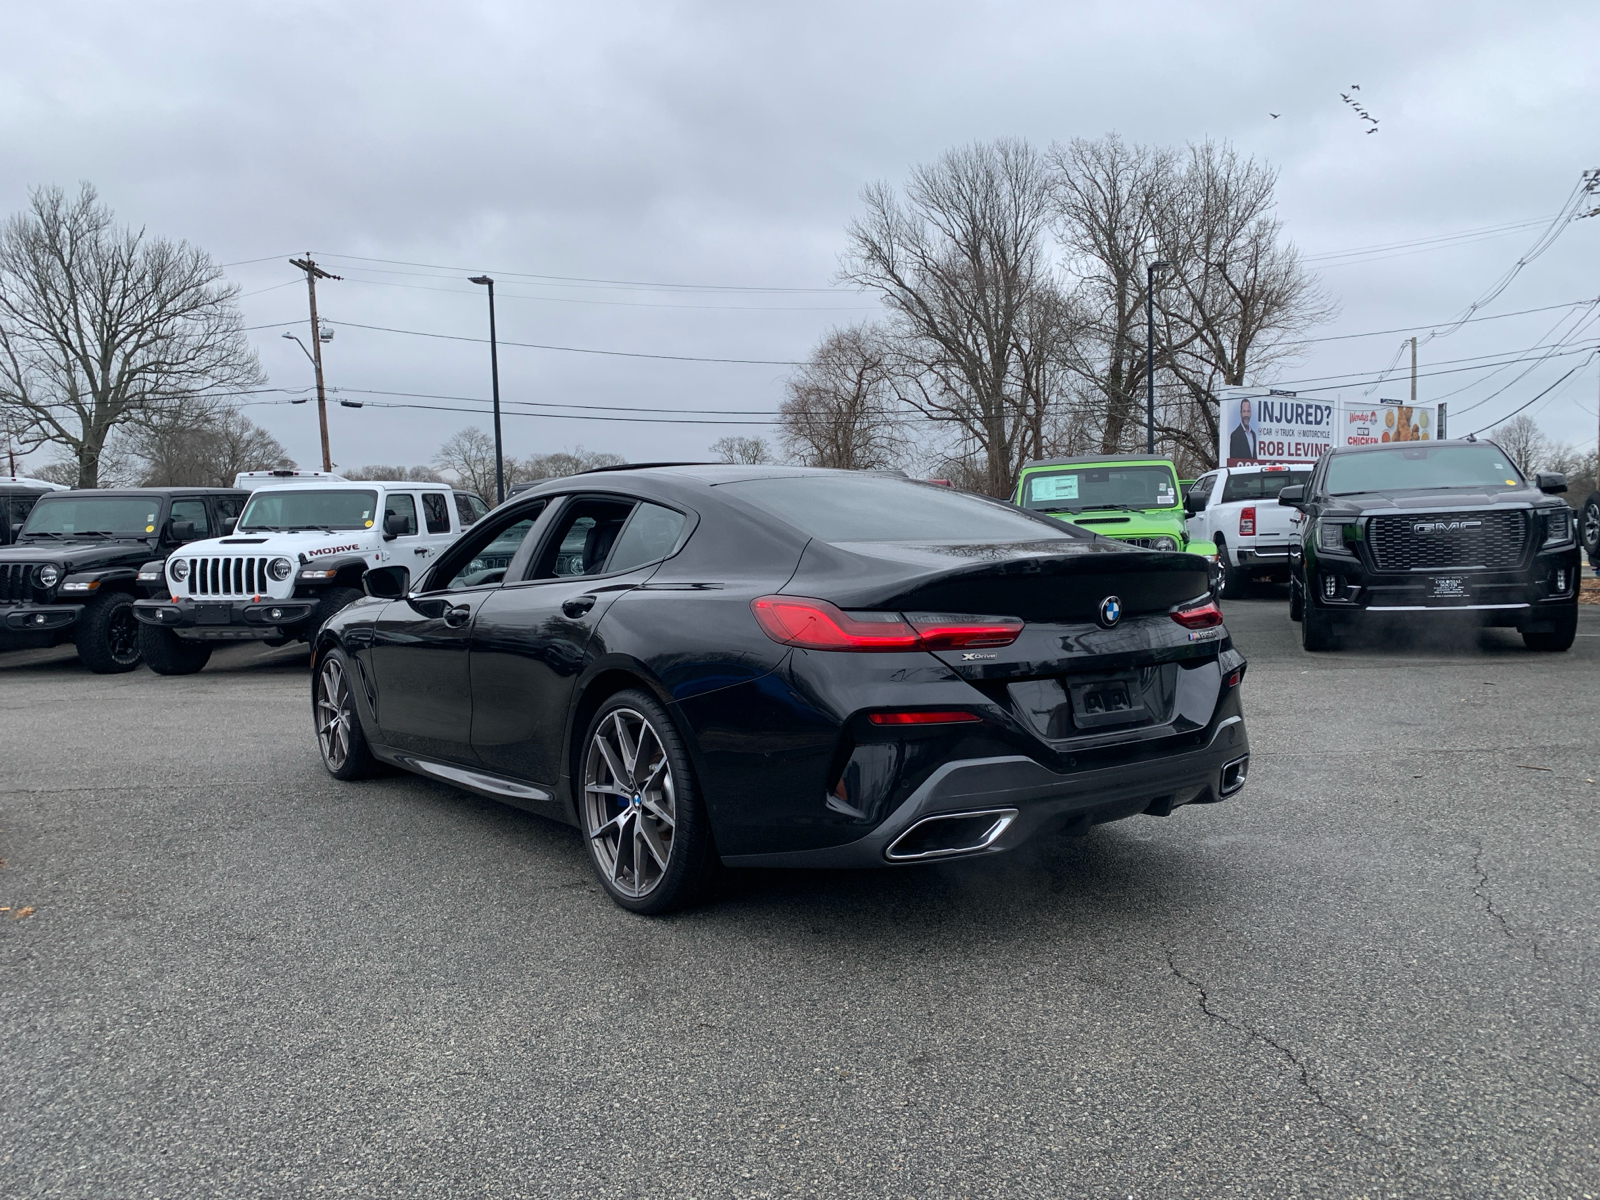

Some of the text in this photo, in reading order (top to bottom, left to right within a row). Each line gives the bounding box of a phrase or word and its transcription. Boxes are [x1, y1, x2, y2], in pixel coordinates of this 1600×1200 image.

[1257, 400, 1332, 426] INJURED?
[1349, 411, 1369, 425] Wendy's
[1263, 428, 1330, 438] CAR TRUCK MOTORCYCLE
[1258, 440, 1285, 457] ROB
[1414, 521, 1482, 535] GMC
[308, 543, 360, 557] MOJAVE
